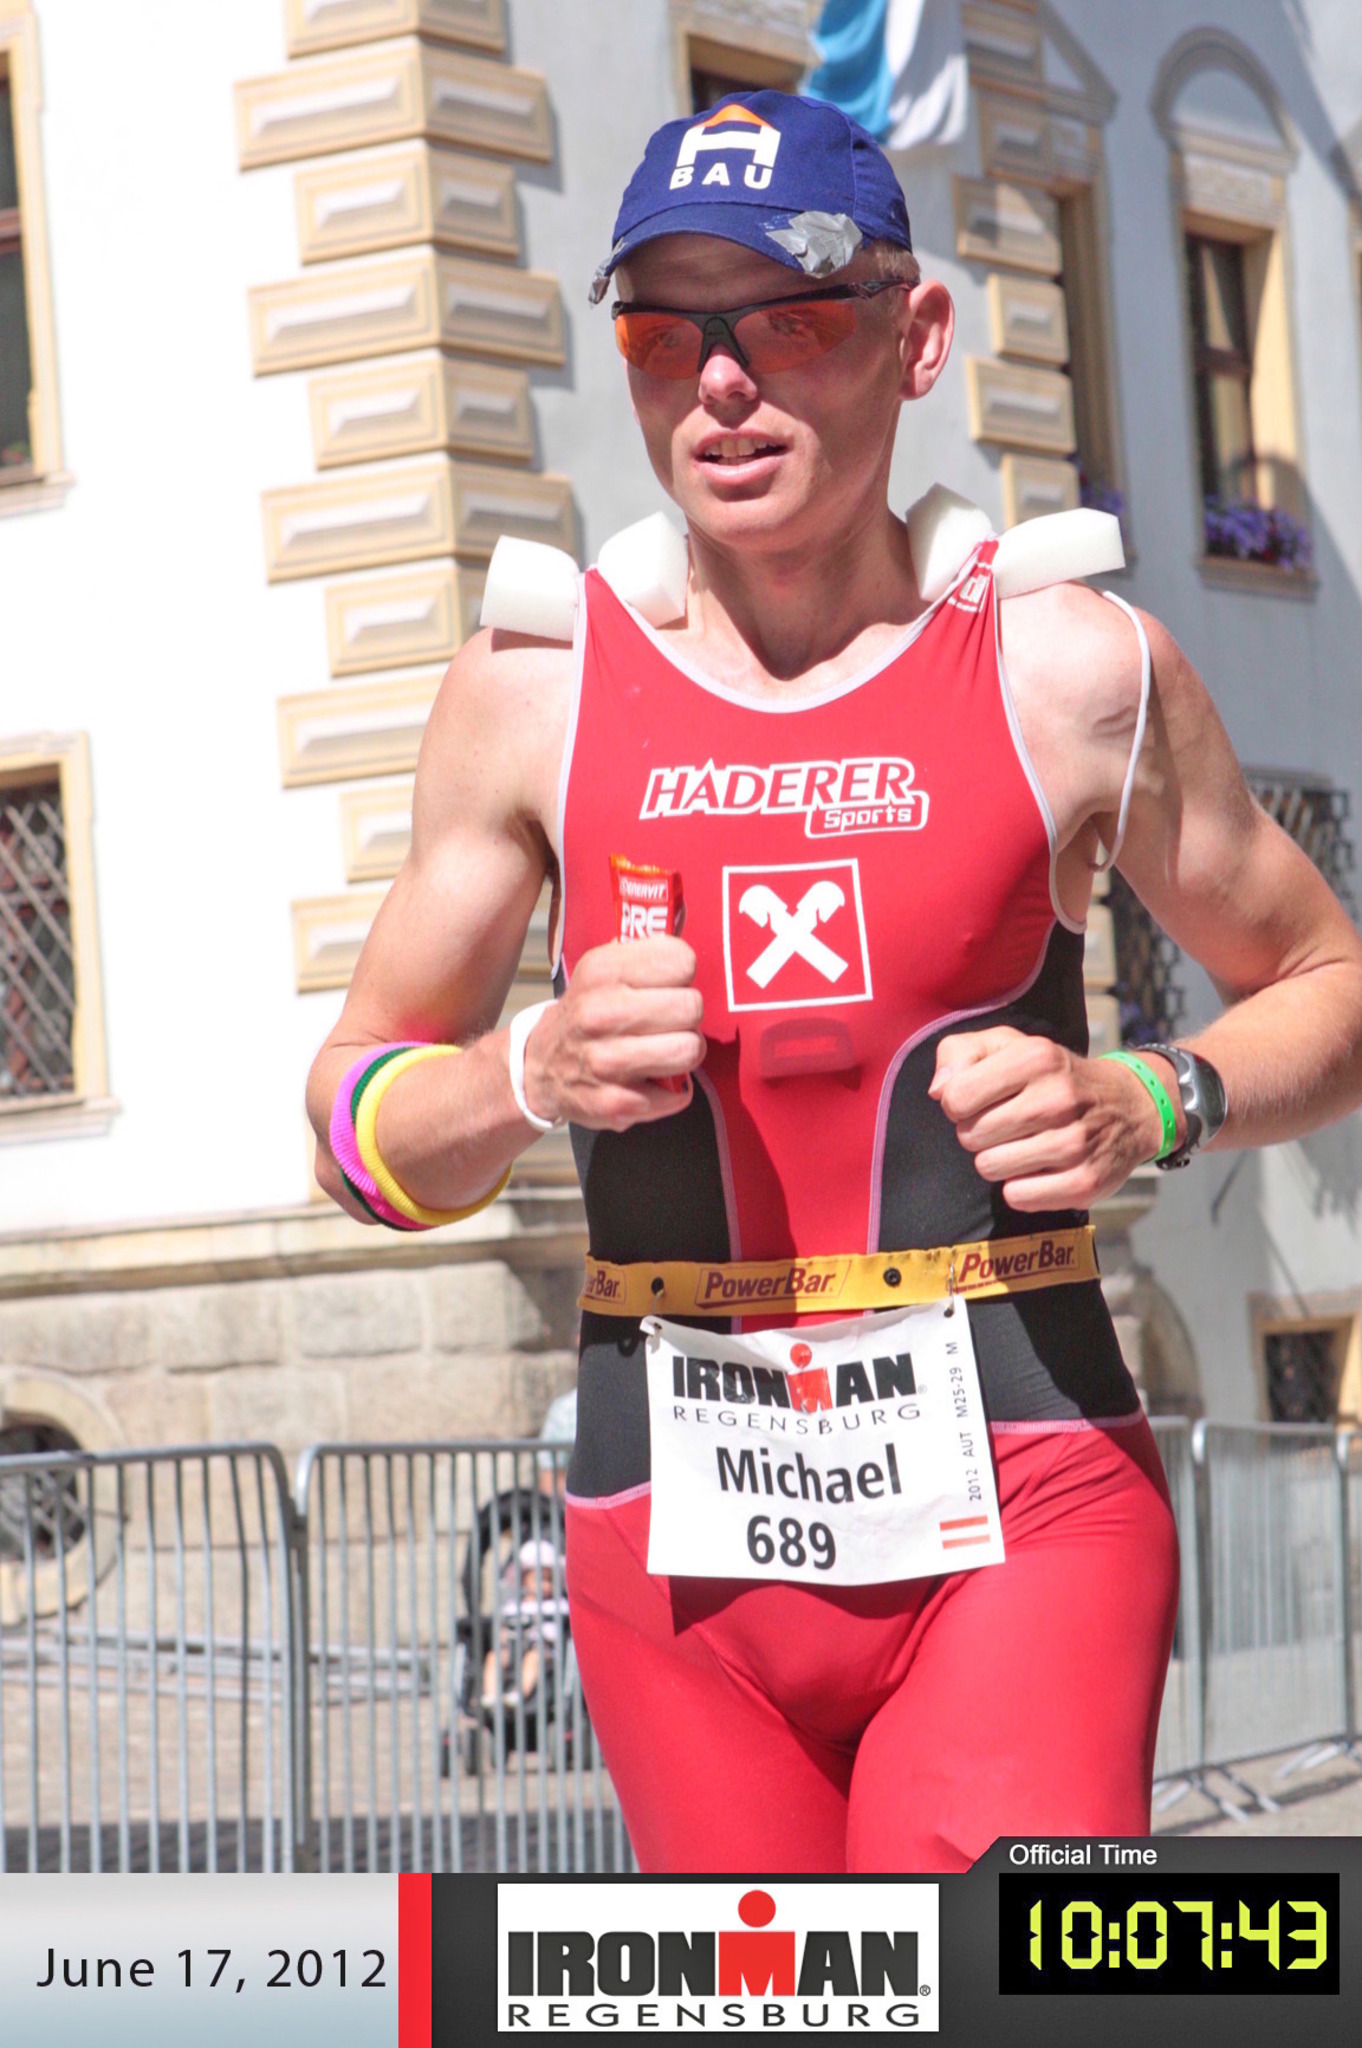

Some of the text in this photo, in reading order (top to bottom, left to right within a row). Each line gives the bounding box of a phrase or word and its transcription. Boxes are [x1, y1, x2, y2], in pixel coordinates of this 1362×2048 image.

[669, 162, 773, 190] BAU
[639, 757, 916, 819] HADERER
[823, 804, 913, 832] Sports
[621, 902, 668, 938] PRE
[672, 1342, 917, 1413] IRONMAN
[949, 1366, 969, 1419] M25-29
[673, 1403, 921, 1436] REGENSBURG
[960, 1431, 975, 1458] AUT
[716, 1442, 901, 1503] Michael
[965, 1468, 982, 1502] 2012
[746, 1515, 837, 1571] 689
